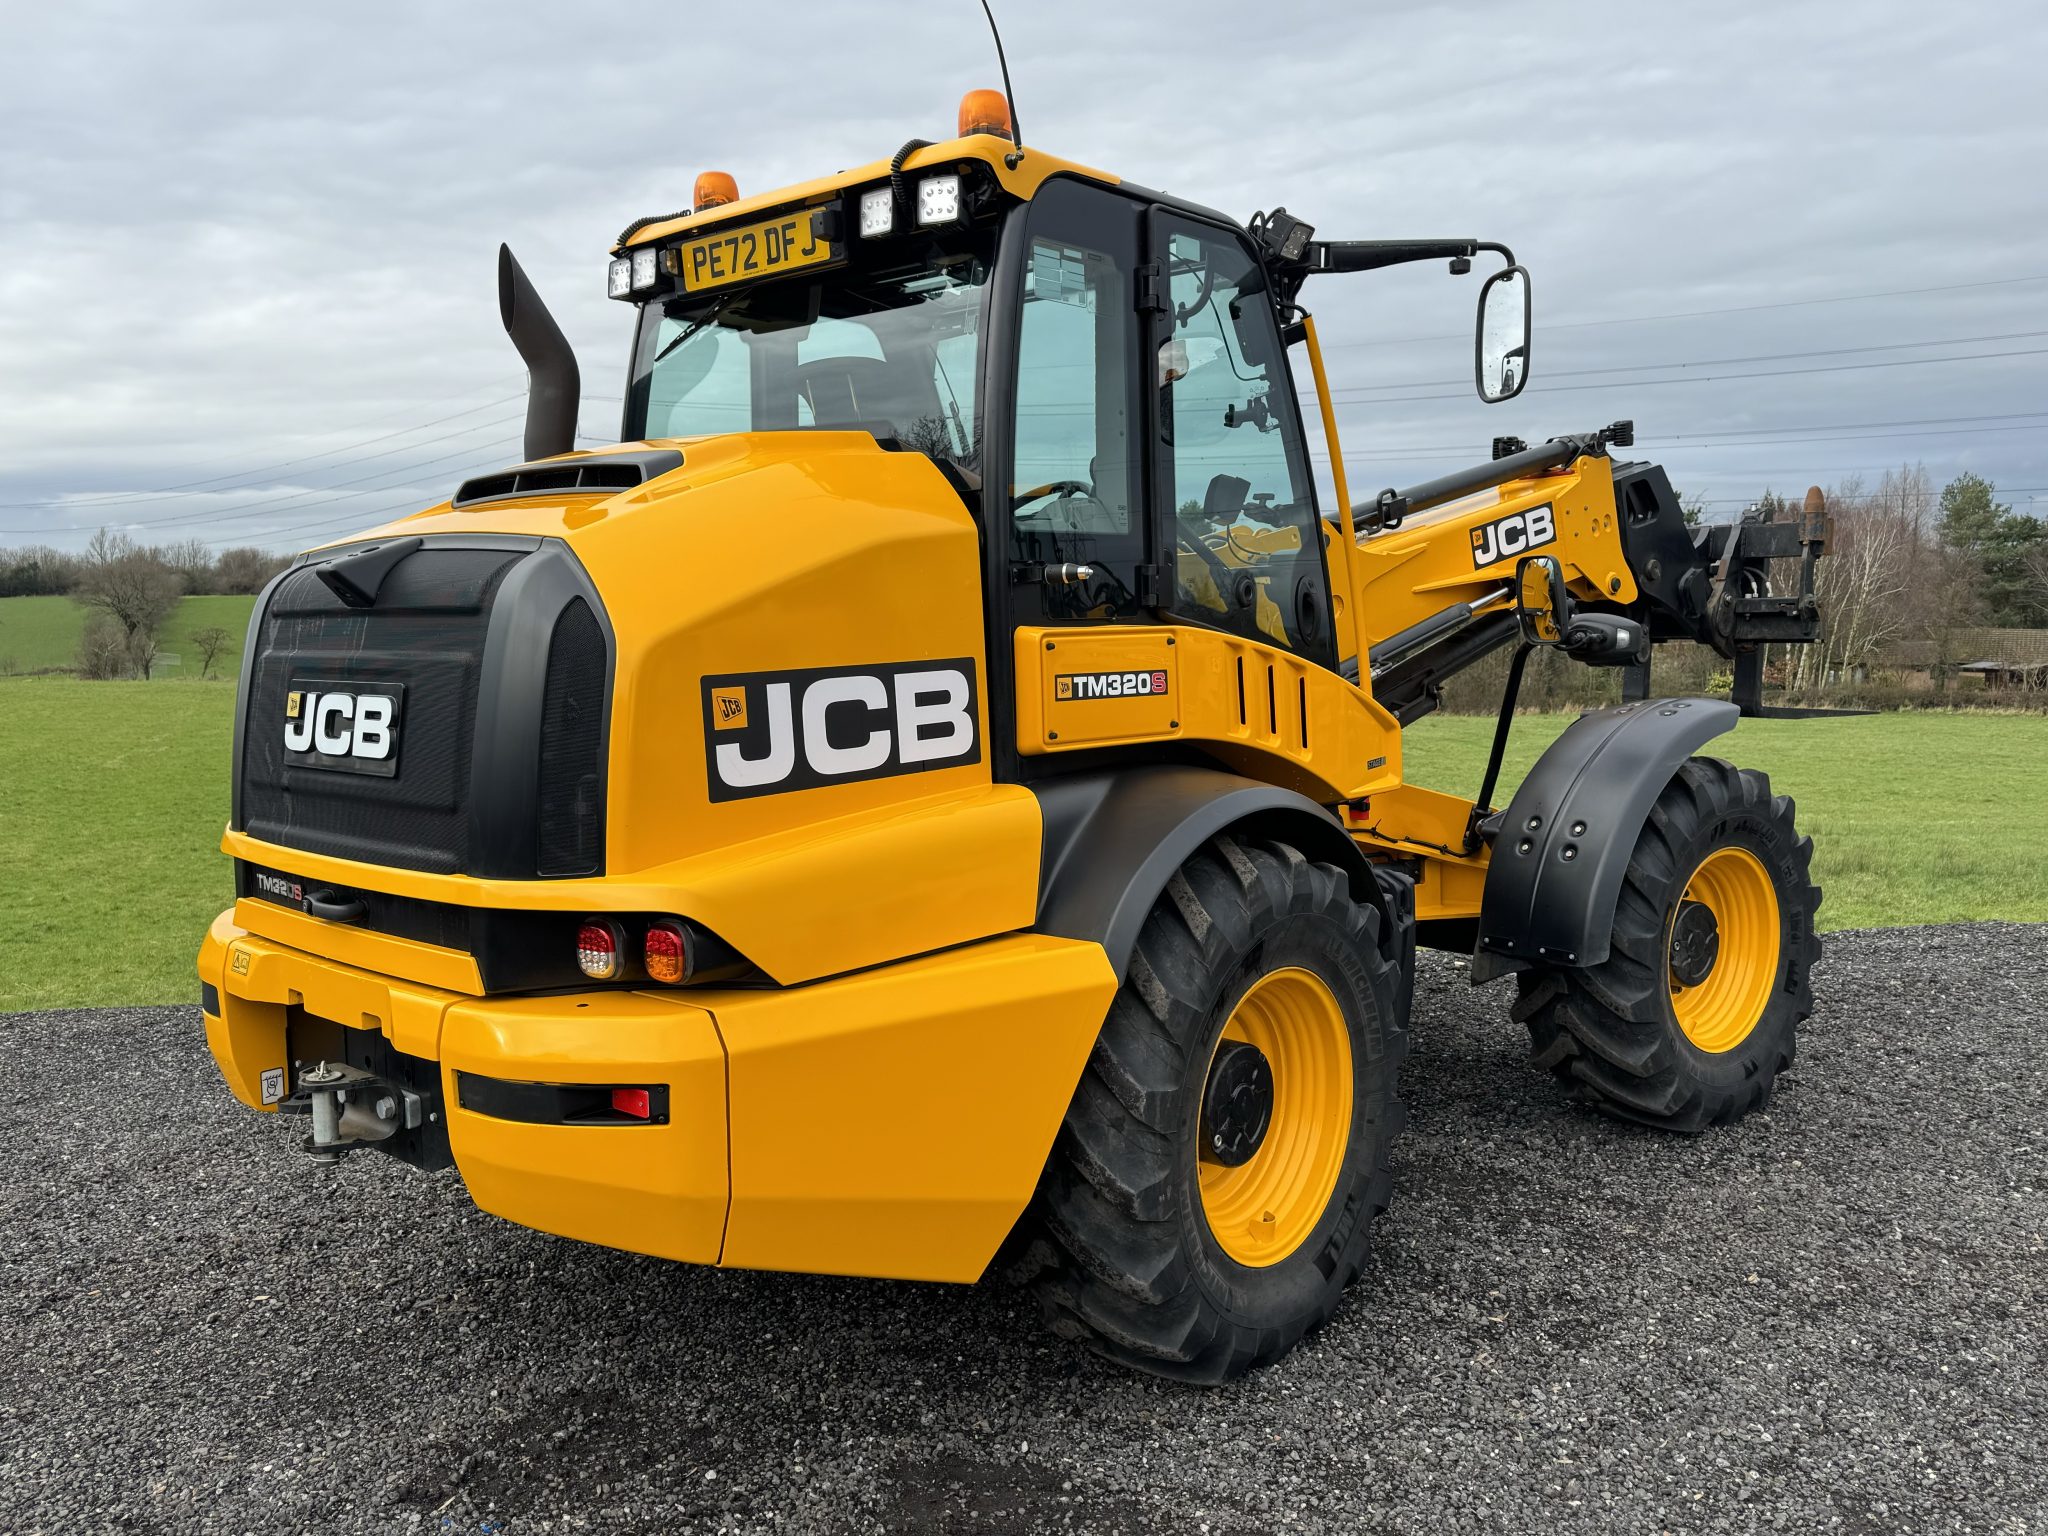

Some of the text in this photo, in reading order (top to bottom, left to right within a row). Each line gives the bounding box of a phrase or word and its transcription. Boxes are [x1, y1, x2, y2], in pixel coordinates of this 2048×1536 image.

[692, 233, 759, 282] PE72
[1475, 507, 1554, 564] JCB
[1073, 672, 1166, 698] TM320S
[285, 691, 394, 759] JCB
[716, 669, 974, 787] JCB
[256, 873, 303, 901] TM320S
